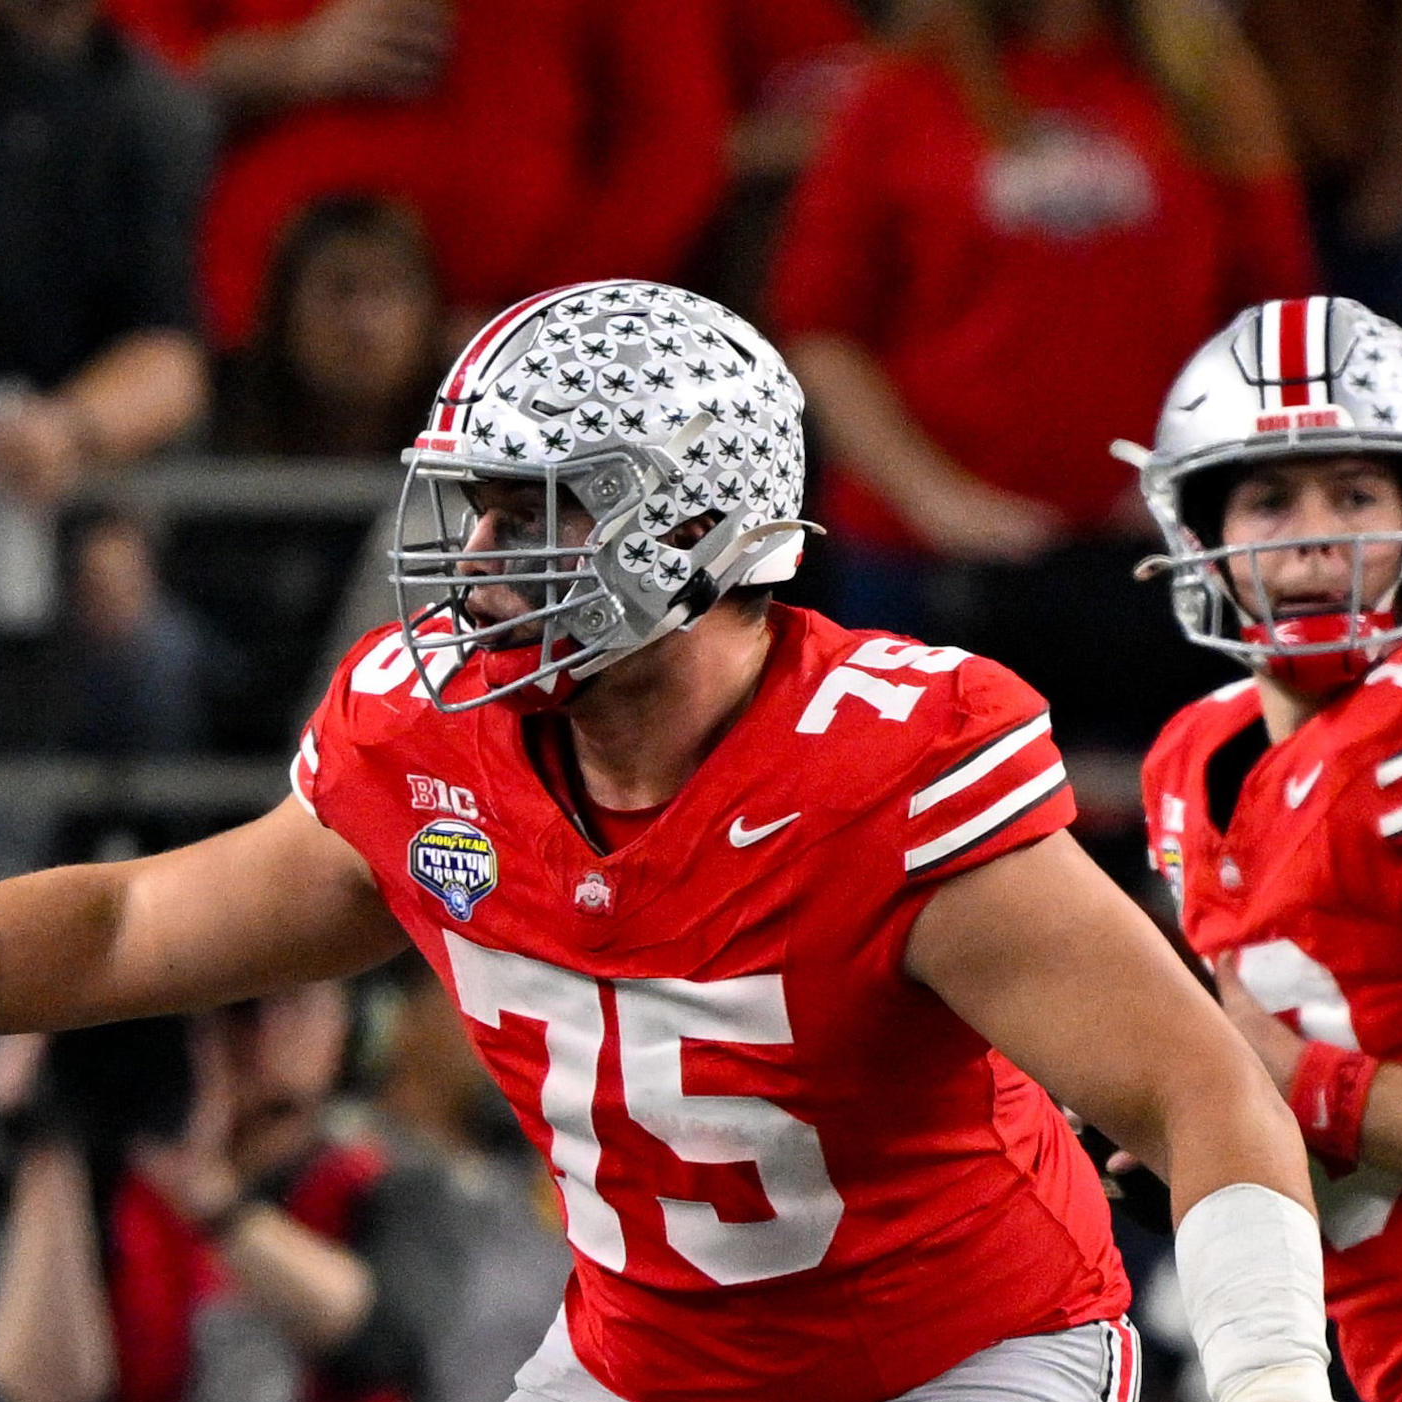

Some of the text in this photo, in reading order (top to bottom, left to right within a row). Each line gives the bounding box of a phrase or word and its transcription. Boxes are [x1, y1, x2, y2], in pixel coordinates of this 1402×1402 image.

[795, 637, 974, 734] 75
[418, 847, 490, 880] COTTON
[420, 834, 488, 851] GOODYEAR
[443, 930, 845, 1287] 75
